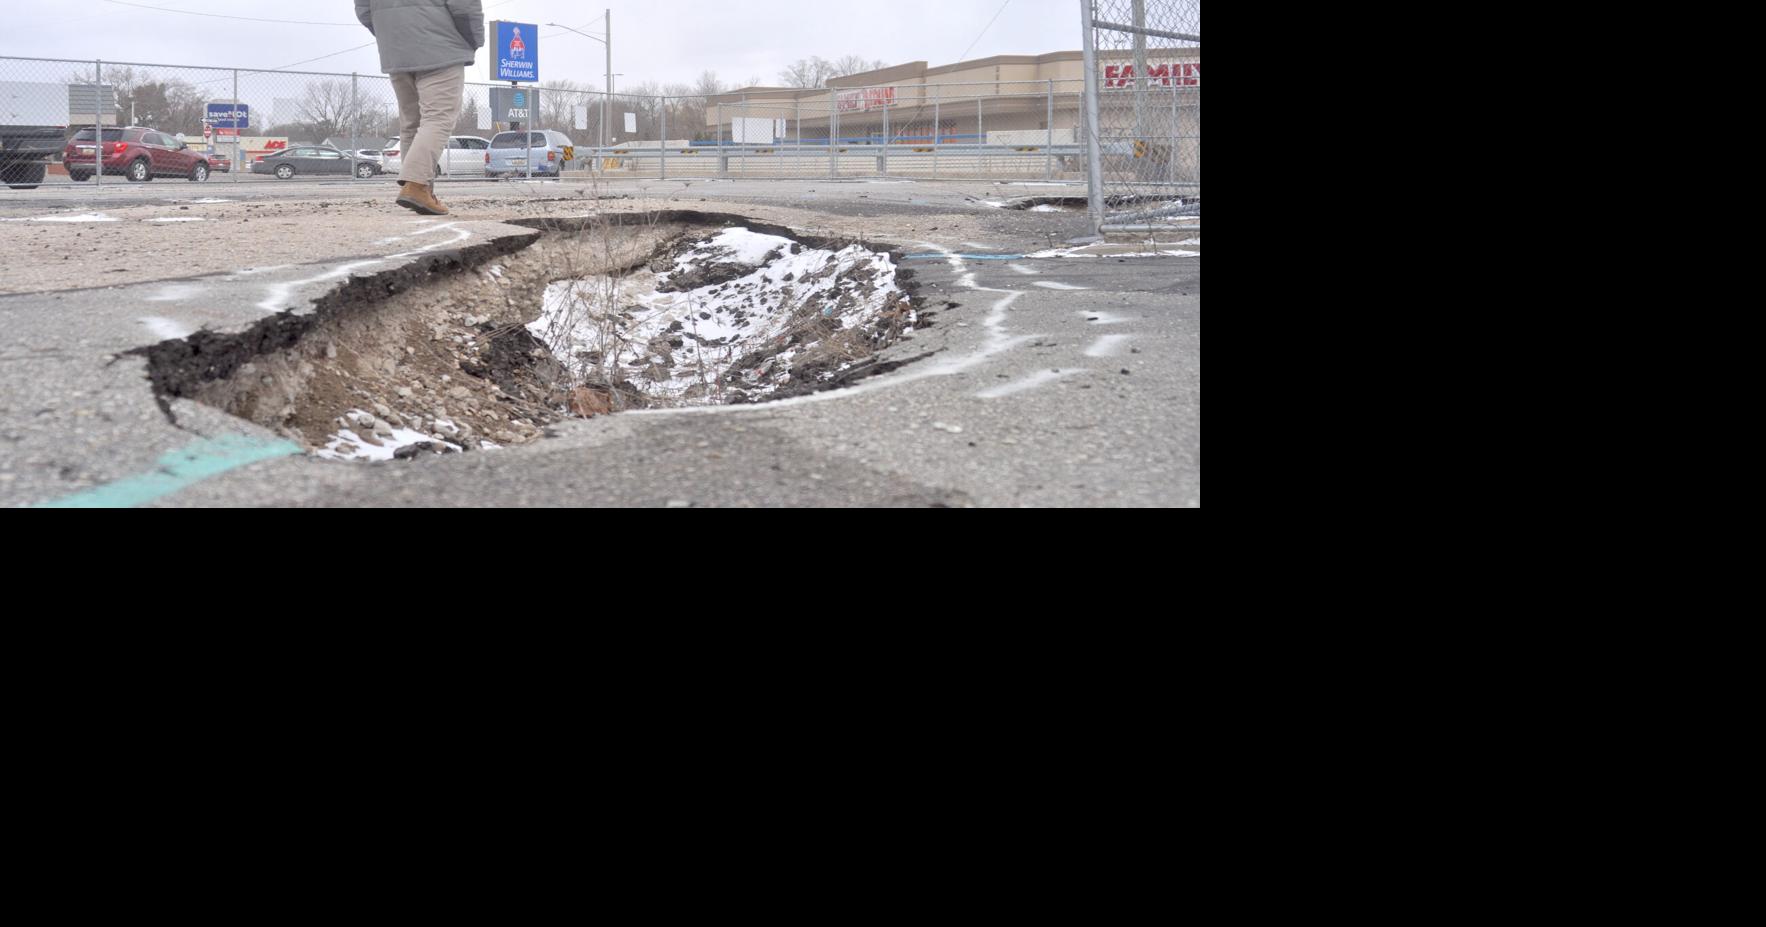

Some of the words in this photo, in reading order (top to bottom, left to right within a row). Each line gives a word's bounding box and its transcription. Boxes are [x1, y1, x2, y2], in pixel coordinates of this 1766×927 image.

[501, 58, 533, 68] SHERWIN
[508, 108, 529, 118] AT&T
[264, 140, 286, 149] ACE
